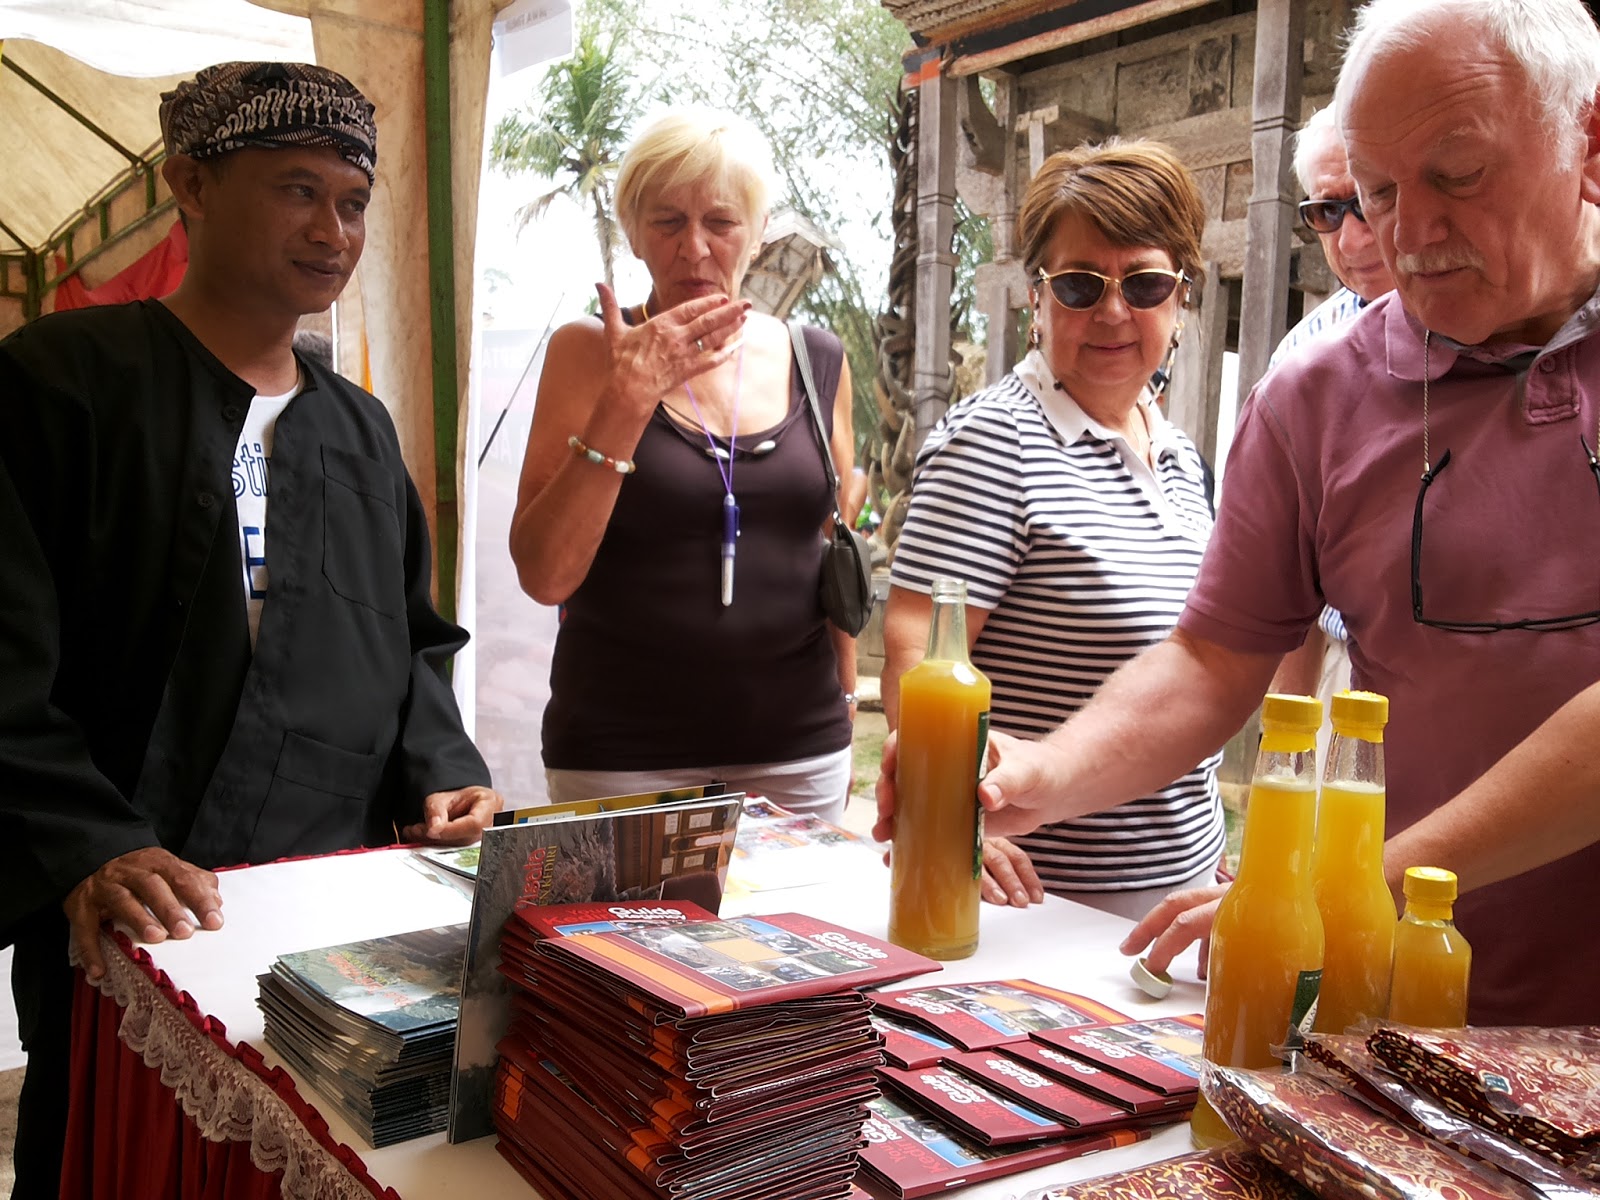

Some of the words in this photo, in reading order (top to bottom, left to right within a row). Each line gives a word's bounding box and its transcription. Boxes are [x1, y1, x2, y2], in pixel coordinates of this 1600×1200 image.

[541, 845, 558, 888] KEDIRI
[608, 907, 682, 916] Guide
[820, 932, 888, 959] Guide
[985, 1060, 1042, 1088] Guide
[920, 1075, 973, 1104] Guide
